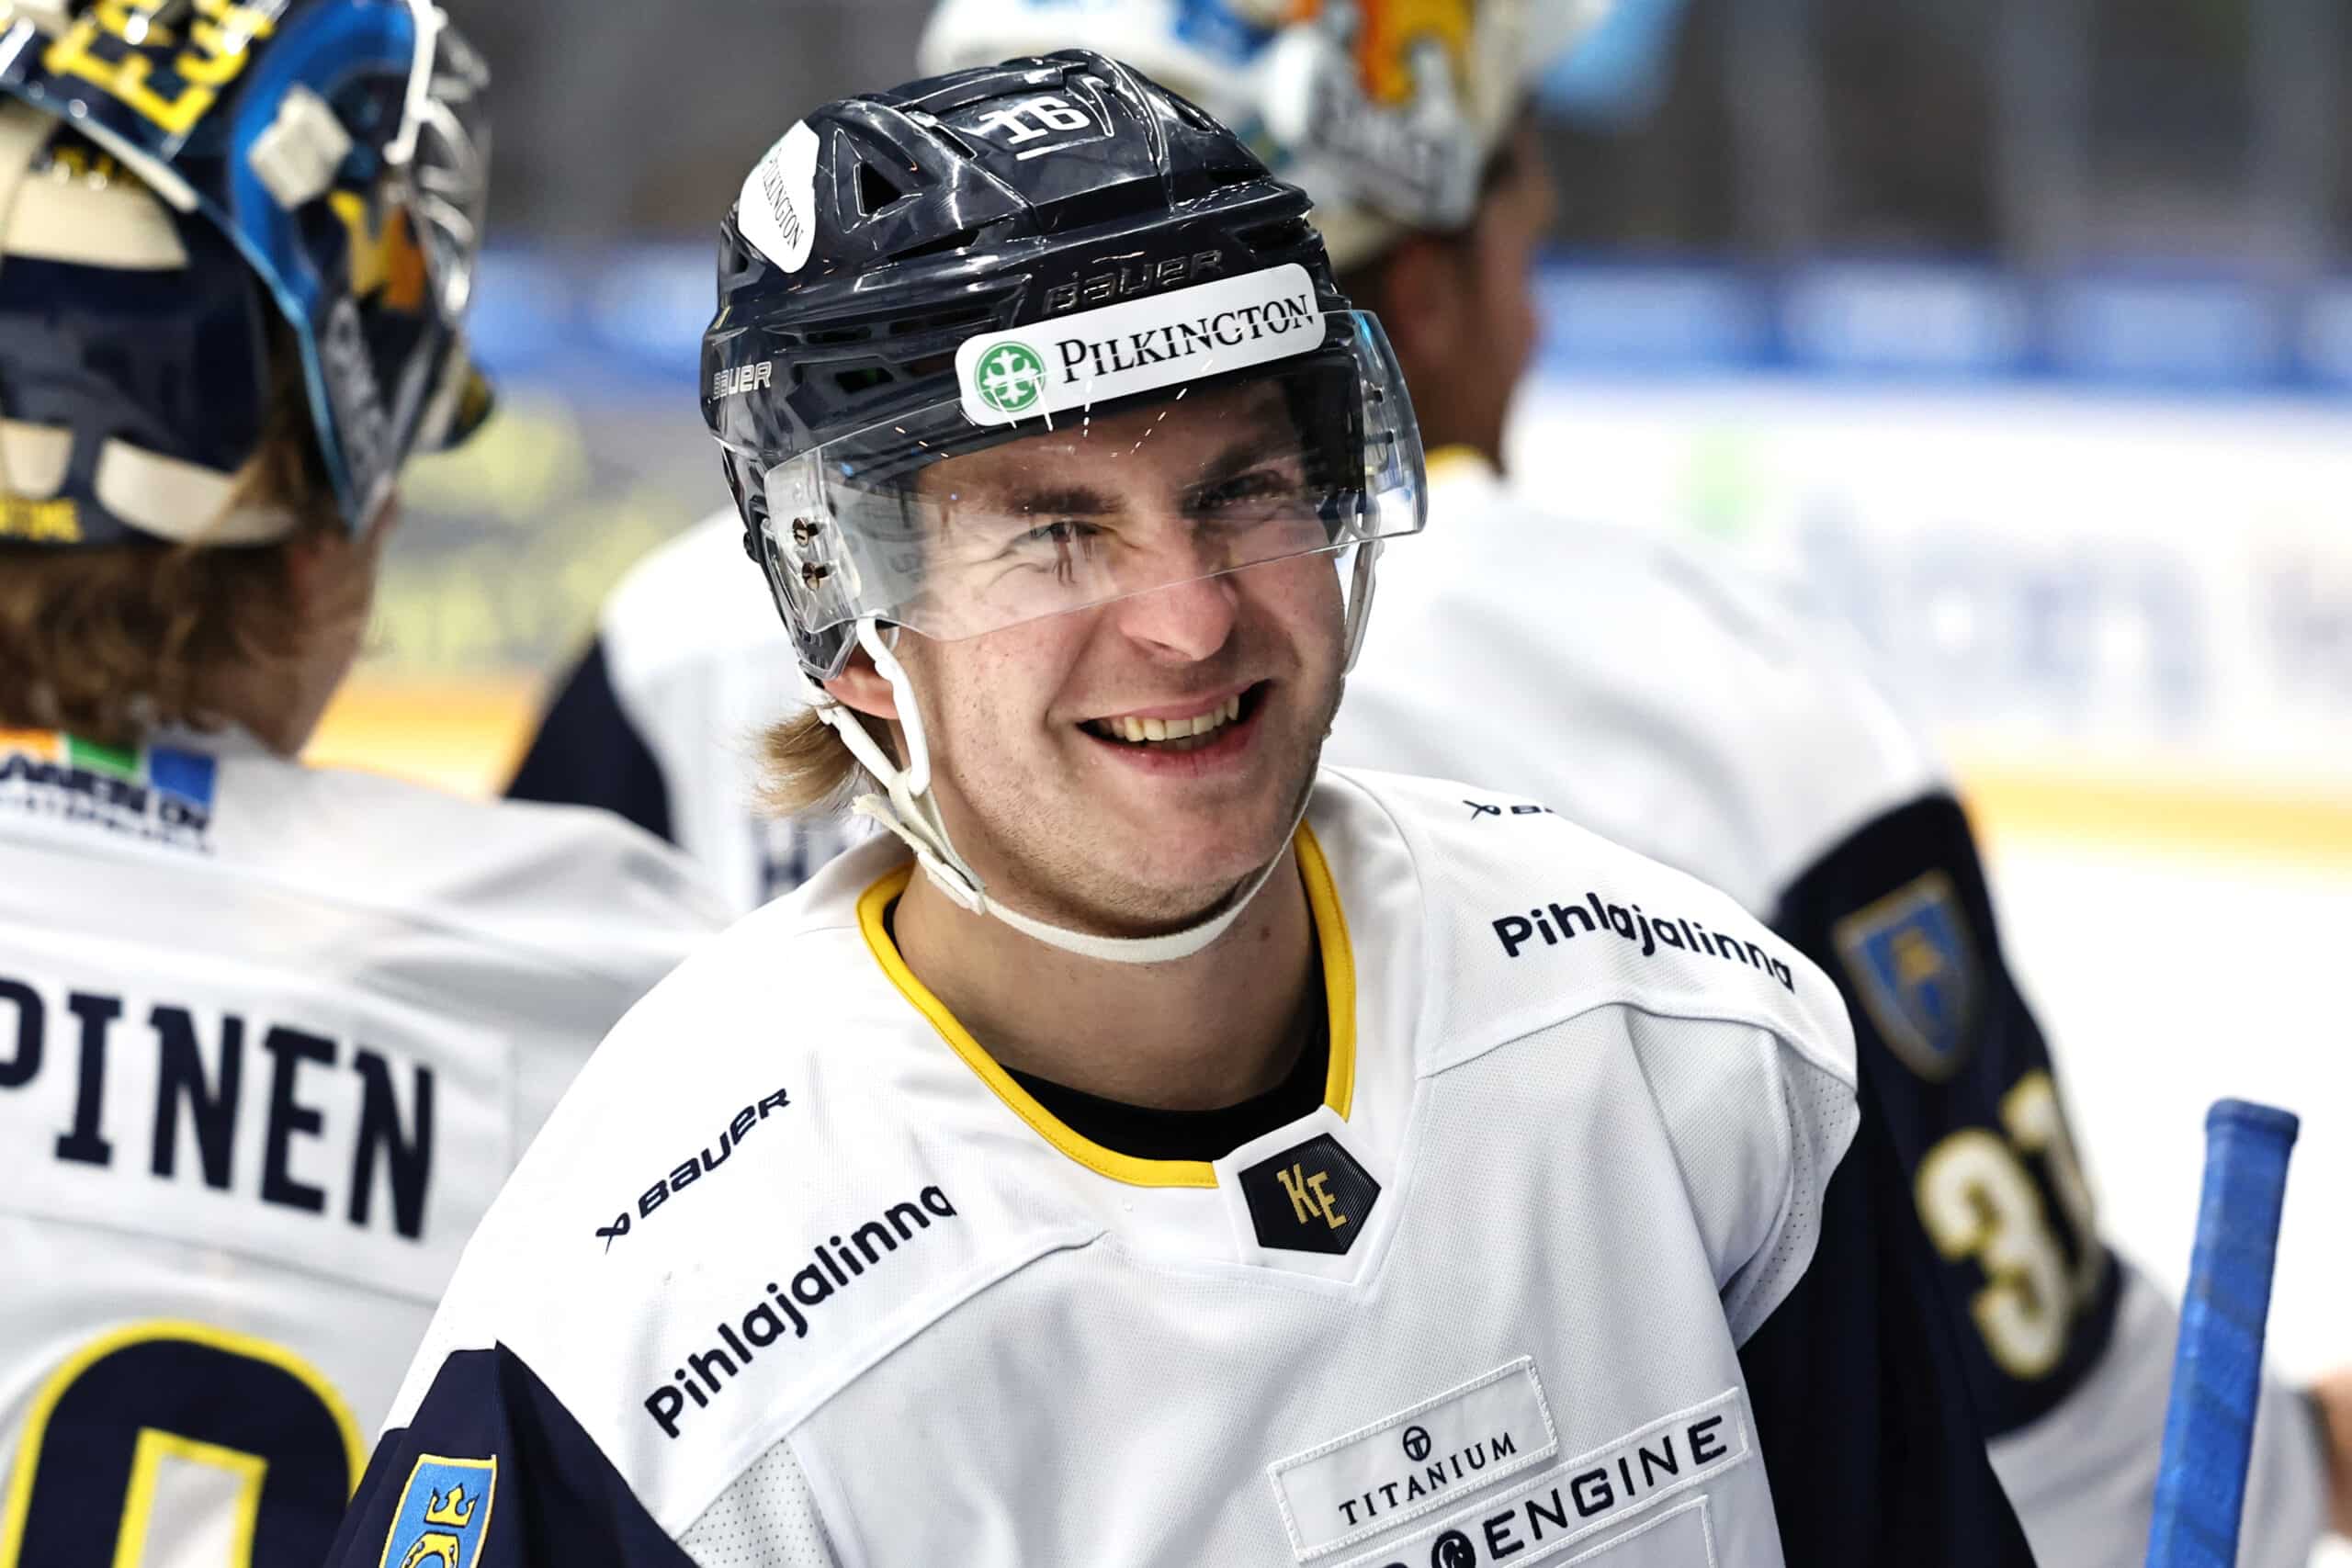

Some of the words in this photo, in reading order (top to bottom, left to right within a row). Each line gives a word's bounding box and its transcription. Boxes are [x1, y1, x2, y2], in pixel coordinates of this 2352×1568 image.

[978, 95, 1091, 145] 16
[1056, 294, 1315, 384] PILKINGTON
[1492, 892, 1795, 993] Pihlajalinna
[1276, 1163, 1347, 1229] KE
[643, 1185, 957, 1438] Pihlajalinna
[1338, 1432, 1517, 1526] TITANIUM
